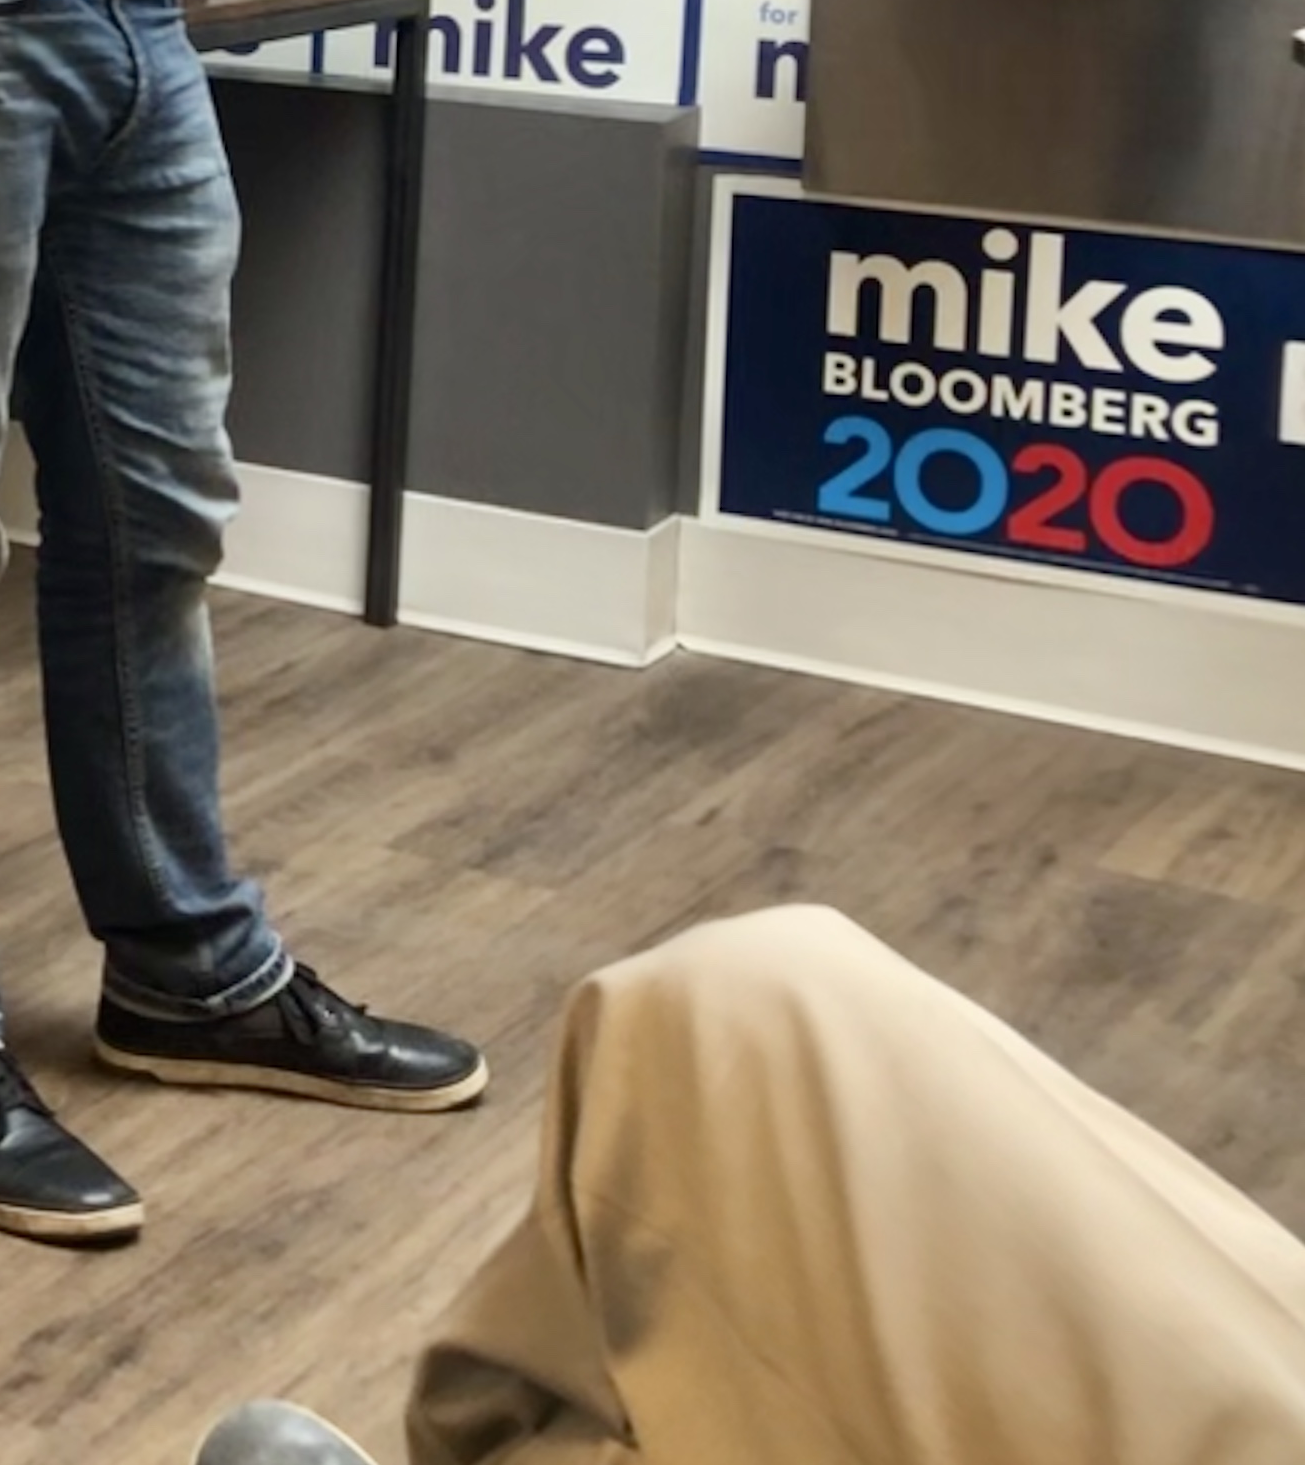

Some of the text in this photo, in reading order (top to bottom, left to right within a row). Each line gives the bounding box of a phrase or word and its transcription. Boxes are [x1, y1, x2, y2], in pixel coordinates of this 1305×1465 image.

[758, 0, 798, 25] for
[826, 227, 1225, 383] mike
[822, 351, 1220, 447] BLOOMBERG
[817, 415, 1215, 568] 2020
